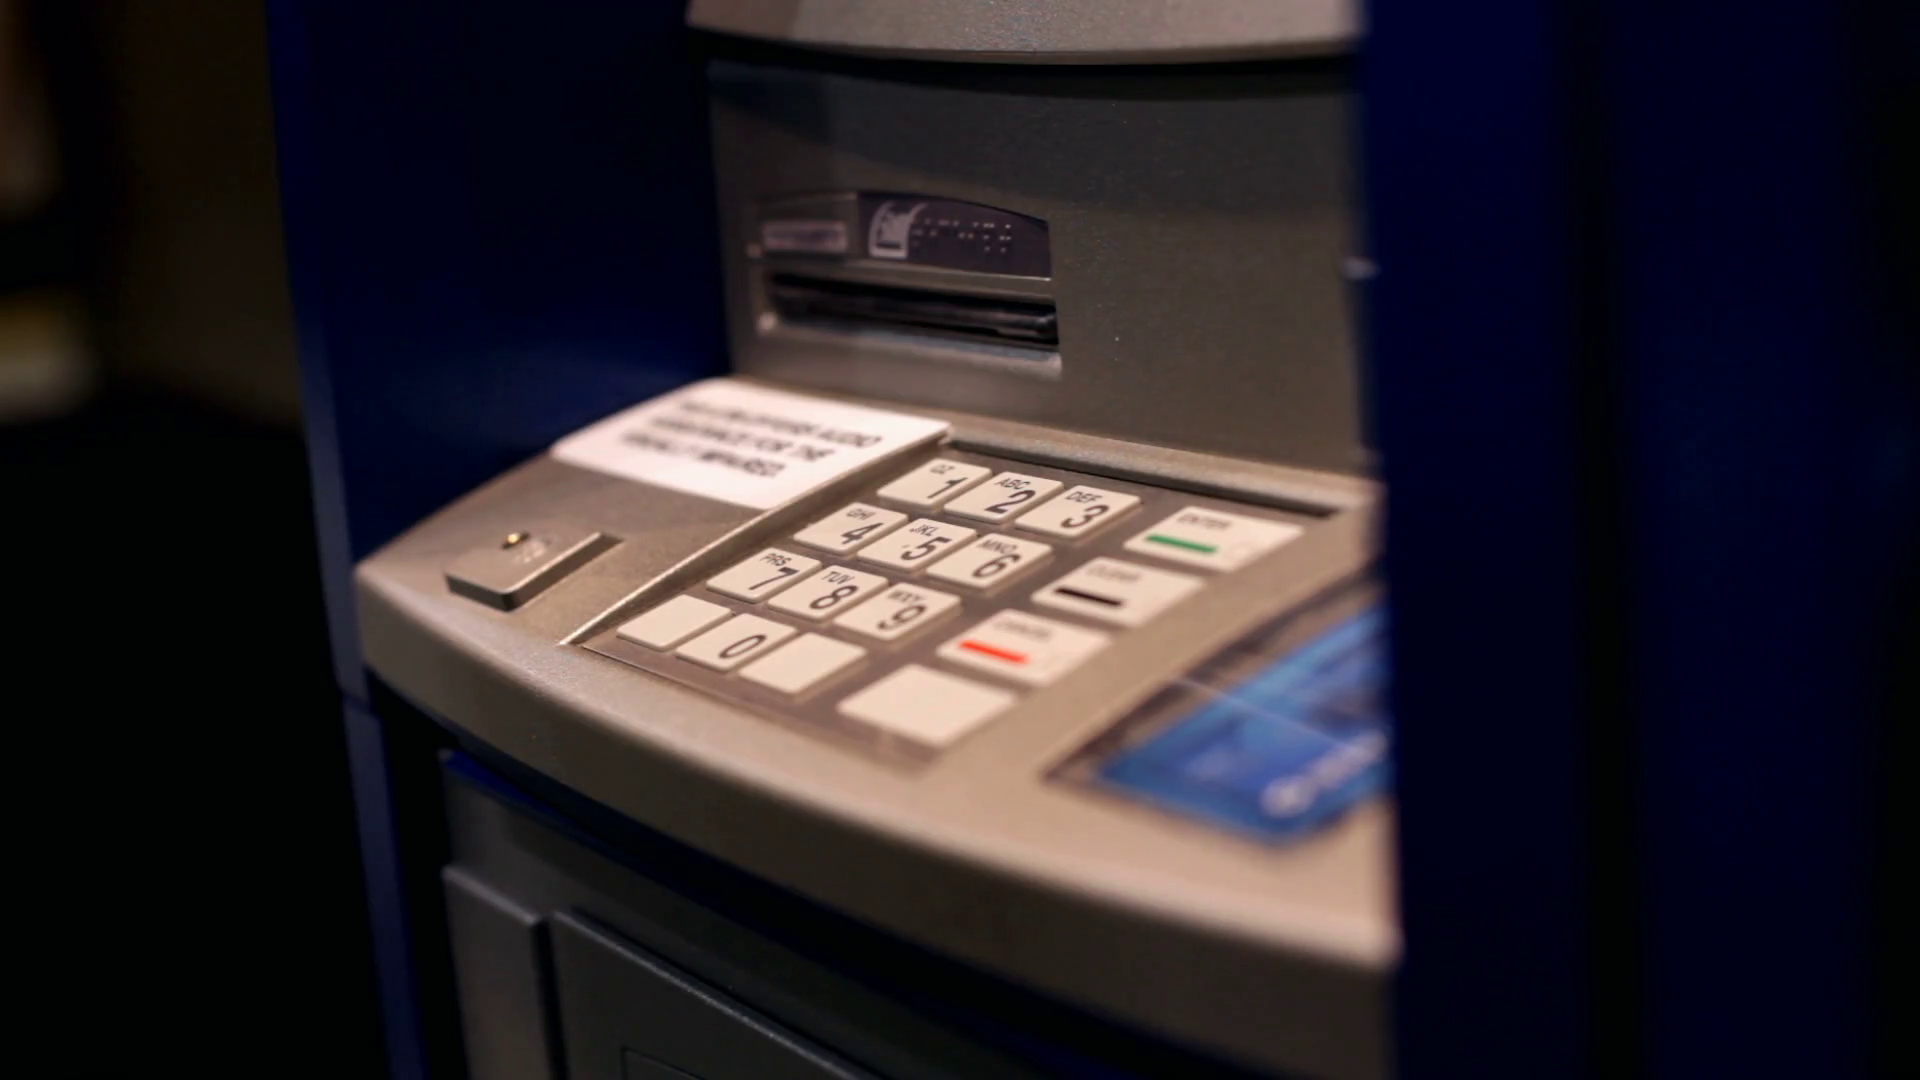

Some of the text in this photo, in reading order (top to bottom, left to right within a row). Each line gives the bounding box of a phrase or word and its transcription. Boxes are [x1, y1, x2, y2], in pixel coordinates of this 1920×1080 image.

[927, 477, 969, 499] 1
[995, 477, 1031, 490] ABC
[984, 489, 1036, 514] 2
[1065, 490, 1105, 503] DEF
[1061, 505, 1109, 529] 3
[841, 523, 883, 544] 4
[908, 523, 938, 537] JKL
[760, 552, 792, 566] PRS
[901, 536, 951, 561] 5
[820, 570, 855, 585] TUV
[973, 553, 1021, 578] 6
[748, 566, 799, 590] 7
[809, 585, 859, 610] 8
[878, 604, 926, 631] 9
[718, 634, 767, 659] 0
